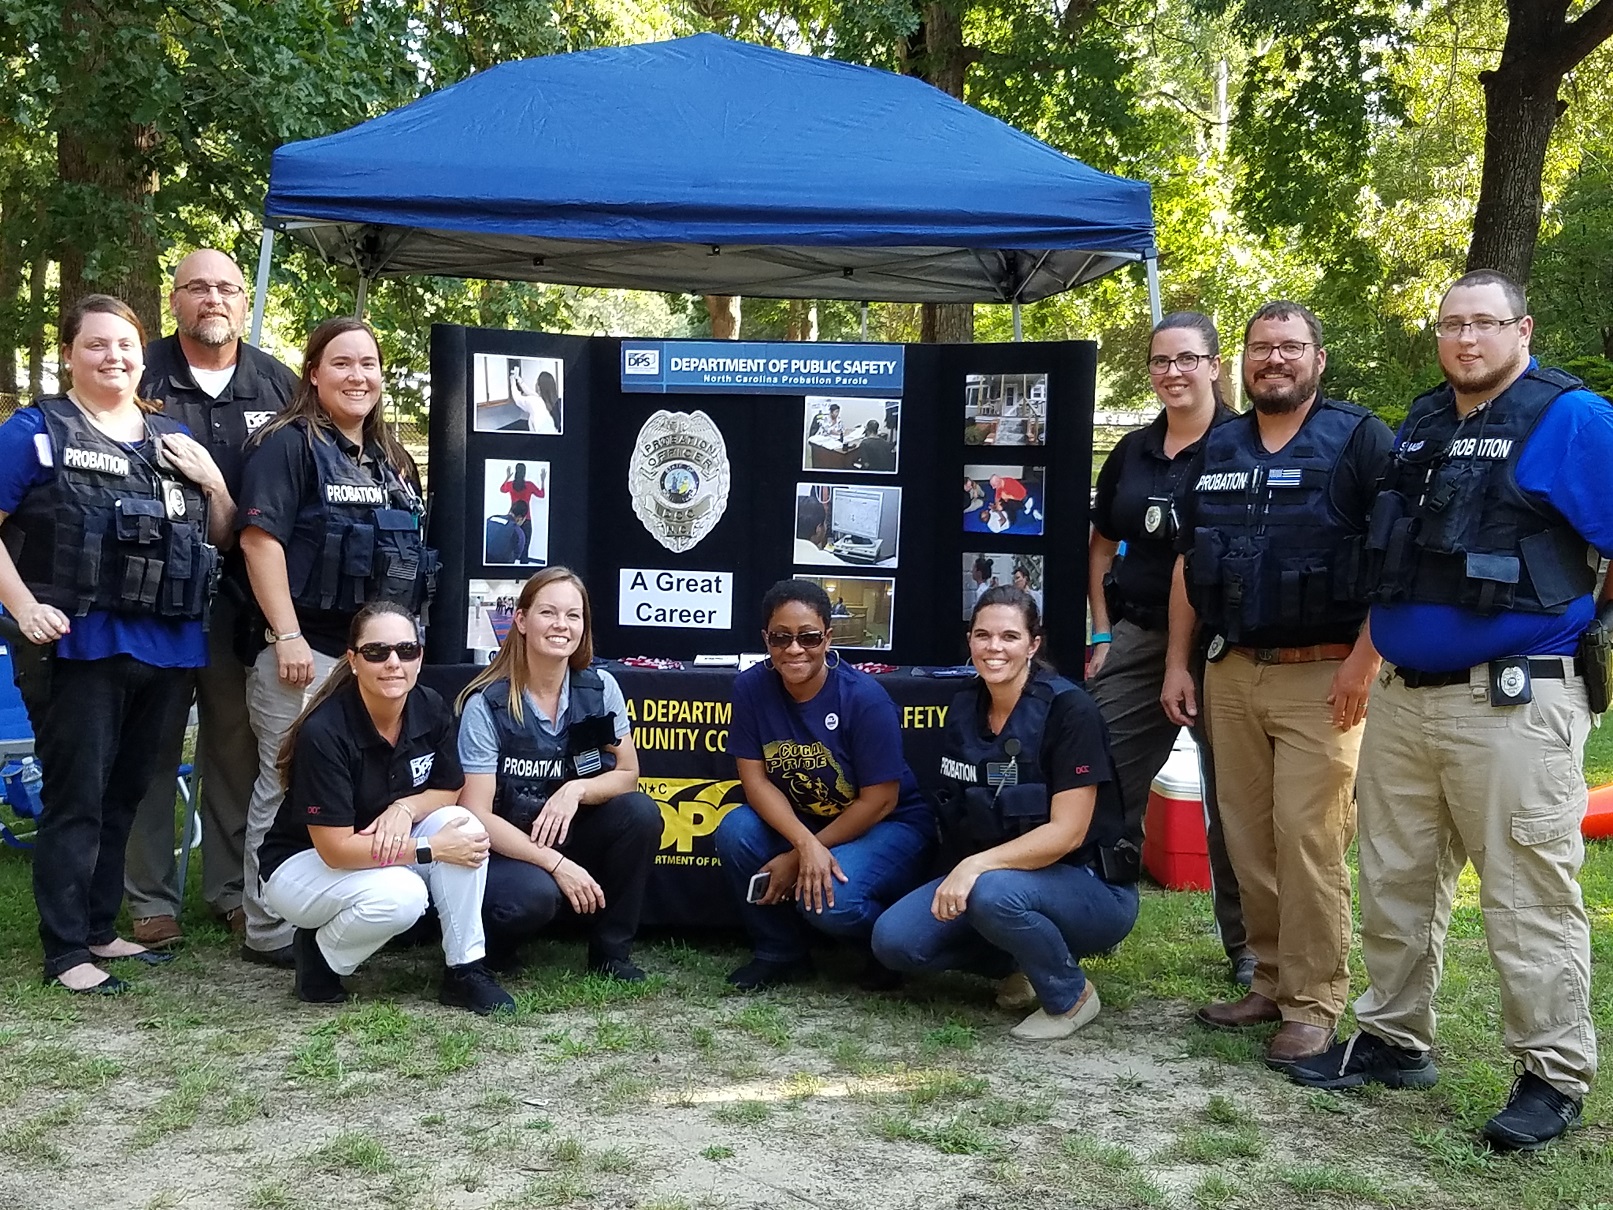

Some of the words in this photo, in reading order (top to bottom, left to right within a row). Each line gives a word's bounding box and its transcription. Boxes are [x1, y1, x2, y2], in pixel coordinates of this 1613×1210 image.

[628, 357, 651, 367] DPS
[670, 357, 766, 373] DEPARTMENT
[768, 359, 789, 373] OF
[791, 360, 842, 374] PUBLIC
[843, 360, 897, 375] SAFETY
[703, 374, 732, 383] North
[735, 375, 778, 384] Carolina
[781, 375, 832, 385] Probation
[835, 376, 868, 385] Parole
[644, 433, 718, 457] PROBATION
[1448, 438, 1513, 458] ROBTION
[65, 447, 129, 476] PROBATION
[648, 448, 713, 470] OFFICER
[1195, 472, 1249, 491] PROBATION
[326, 484, 383, 503] PROBATION
[630, 571, 648, 591] A
[656, 572, 722, 594] Great
[636, 602, 717, 624] Career
[643, 699, 732, 725] DEPARTM
[901, 705, 949, 729] FETY
[940, 756, 978, 783] PROBATION
[696, 856, 710, 867] OF
